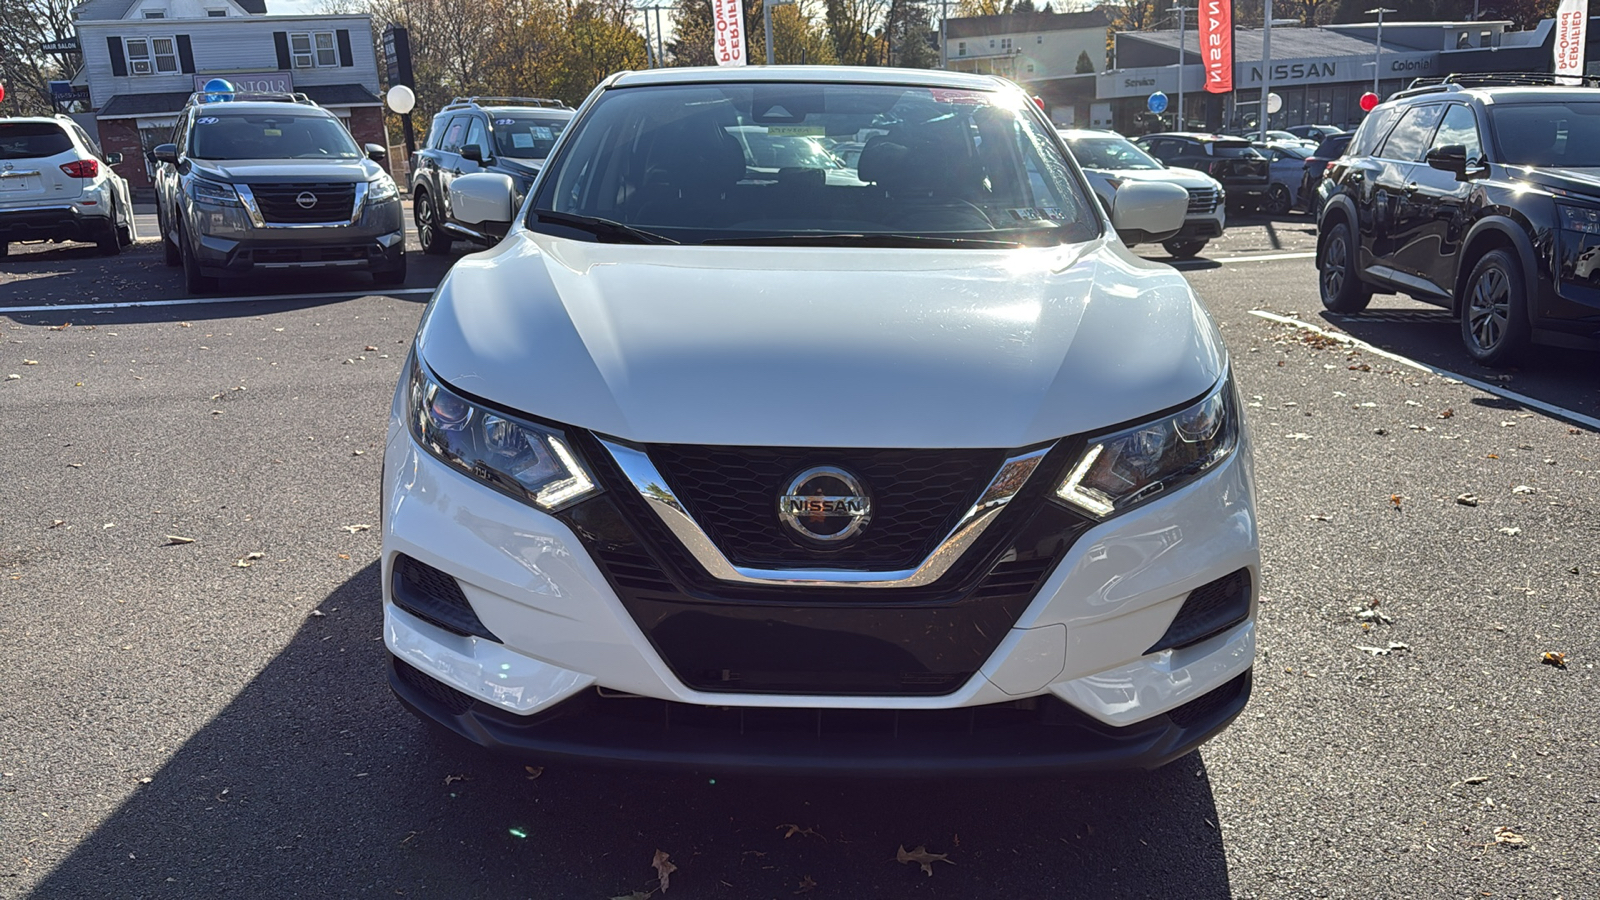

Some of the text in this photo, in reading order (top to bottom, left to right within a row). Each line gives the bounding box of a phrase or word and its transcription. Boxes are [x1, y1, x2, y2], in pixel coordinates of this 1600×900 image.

[1391, 59, 1433, 72] Colonial
[1251, 62, 1336, 82] NISSAN
[1125, 77, 1156, 87] Service
[791, 500, 862, 512] NISSAN
